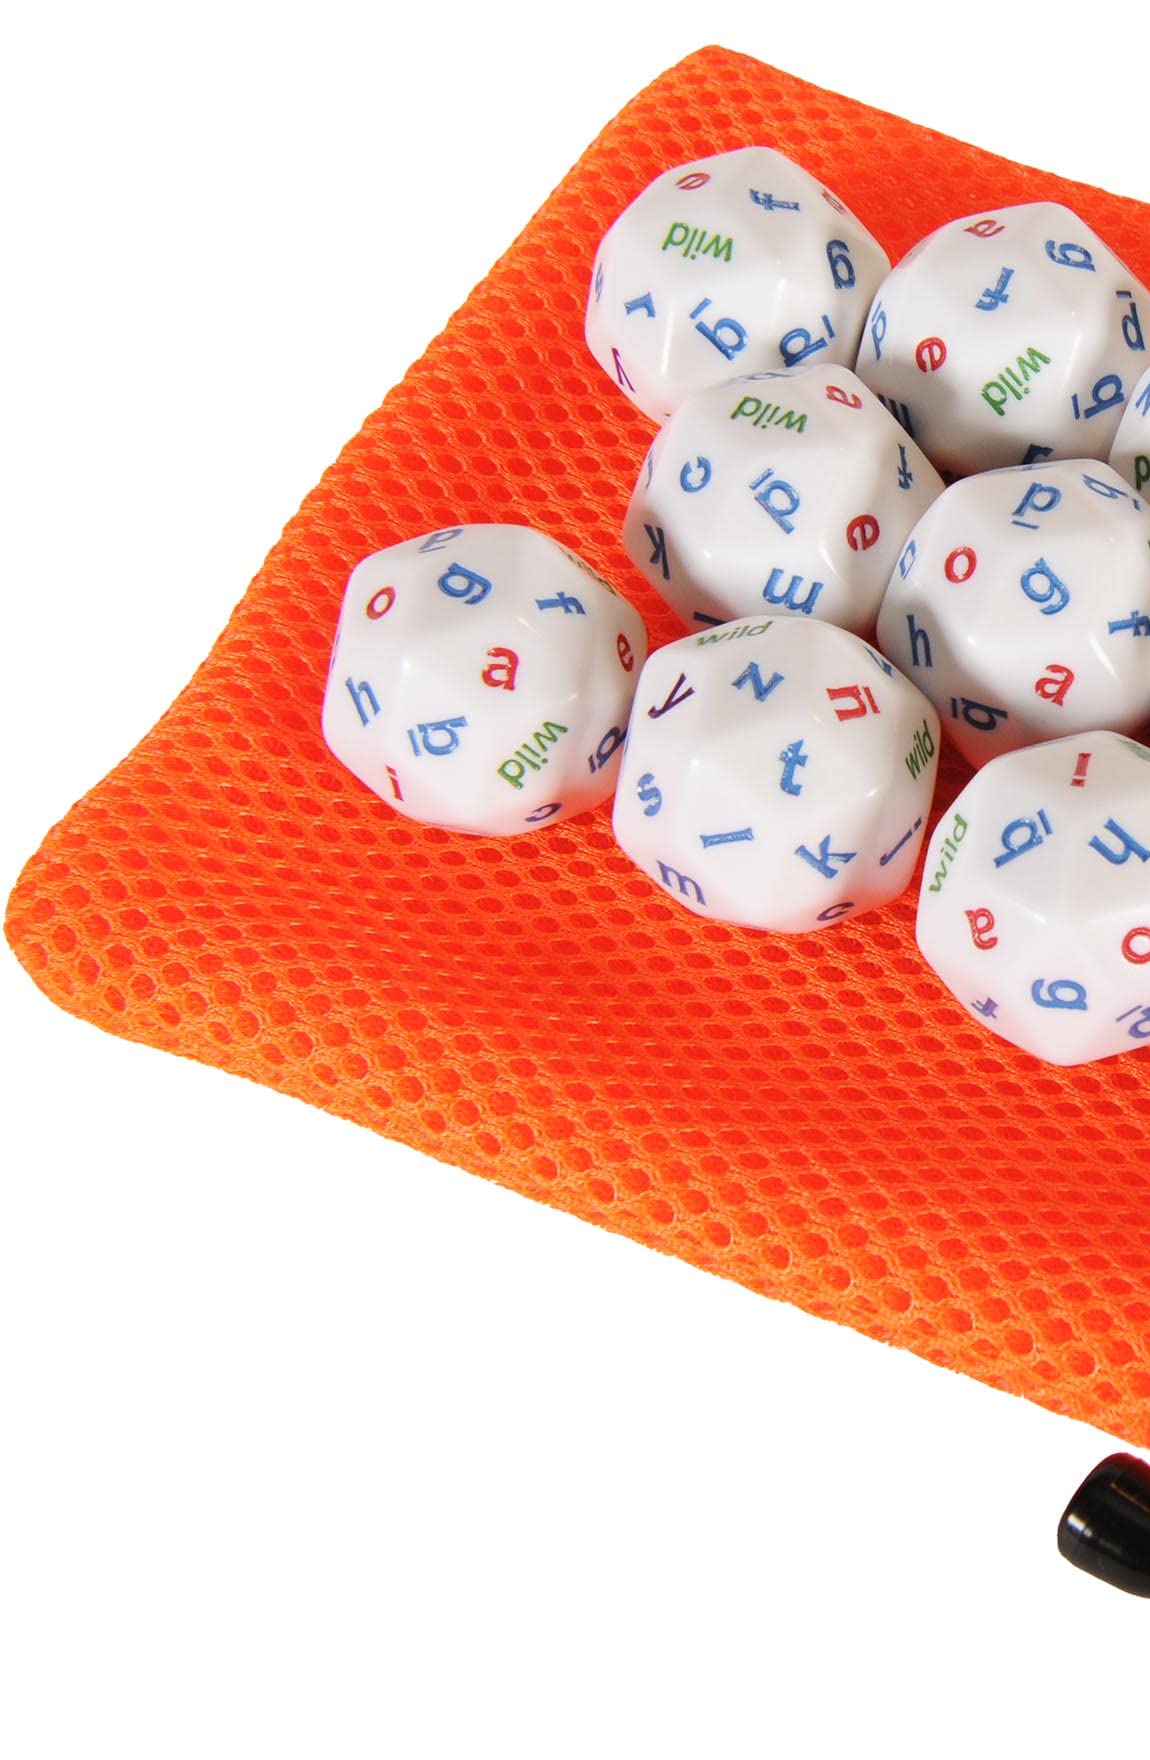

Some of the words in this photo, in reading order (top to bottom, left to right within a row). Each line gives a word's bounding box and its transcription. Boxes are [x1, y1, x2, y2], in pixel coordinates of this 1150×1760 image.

[662, 221, 734, 262] wild
[981, 347, 1051, 416] wild
[730, 395, 809, 434] wild
[944, 546, 977, 584] o
[366, 586, 396, 620] o
[696, 620, 774, 647] wild
[496, 720, 568, 790] wild
[904, 719, 935, 780] wild
[929, 813, 969, 893] wild
